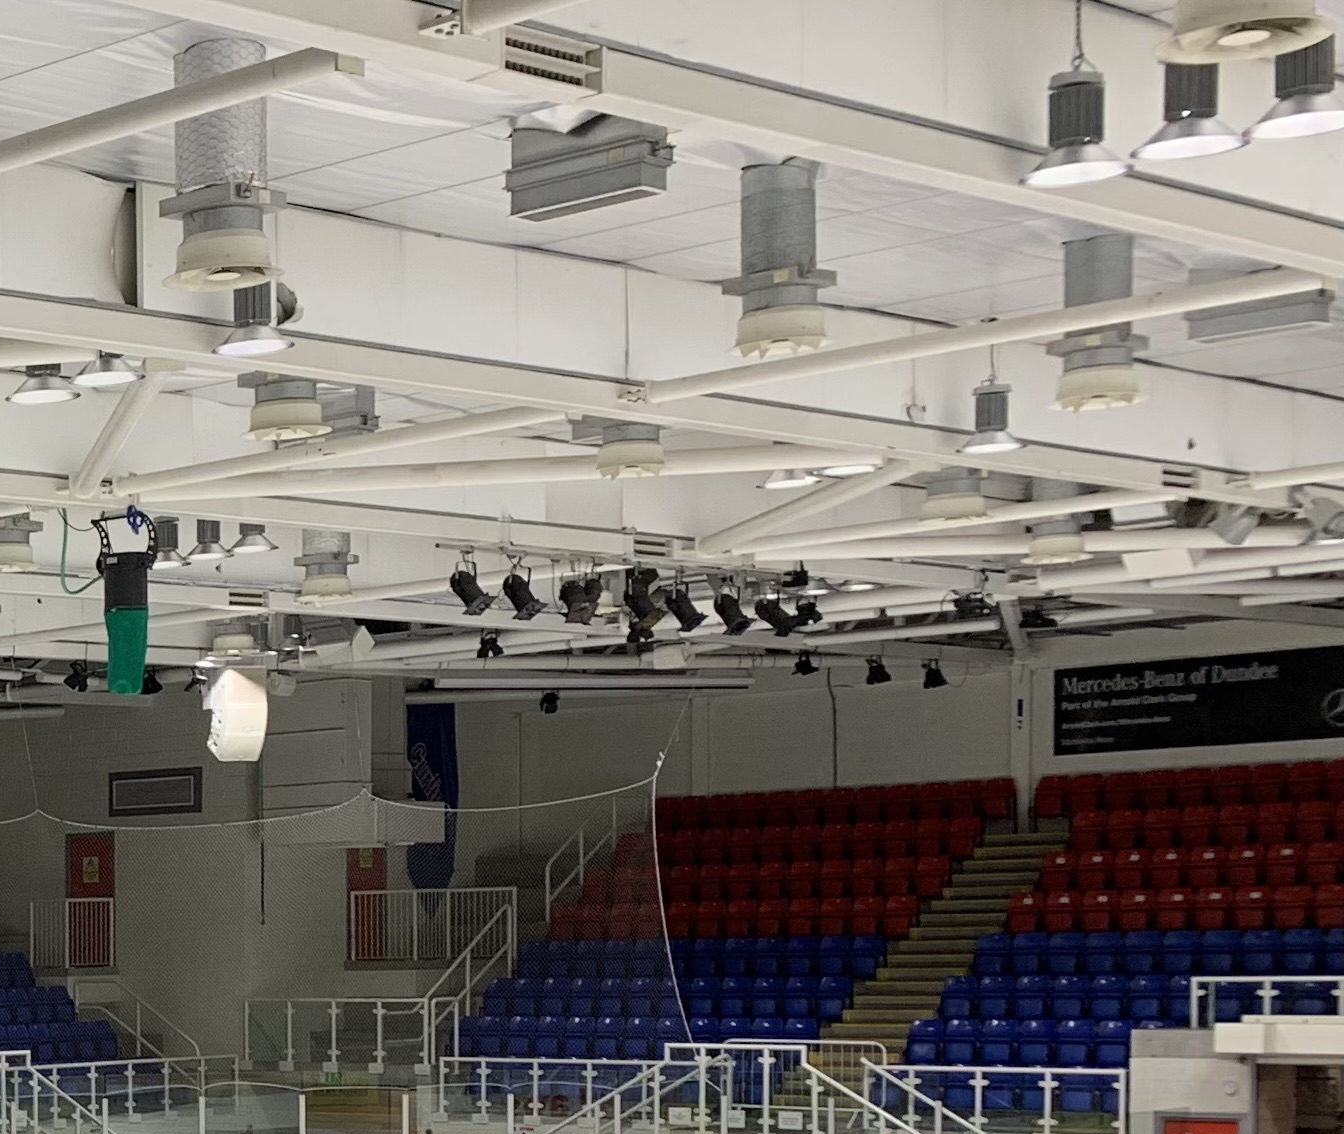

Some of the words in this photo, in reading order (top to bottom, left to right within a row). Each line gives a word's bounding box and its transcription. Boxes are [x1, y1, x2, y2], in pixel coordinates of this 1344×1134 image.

[1061, 669, 1186, 695] Mercedes-Benz
[1191, 666, 1208, 685] of
[1211, 661, 1279, 684] Dundee
